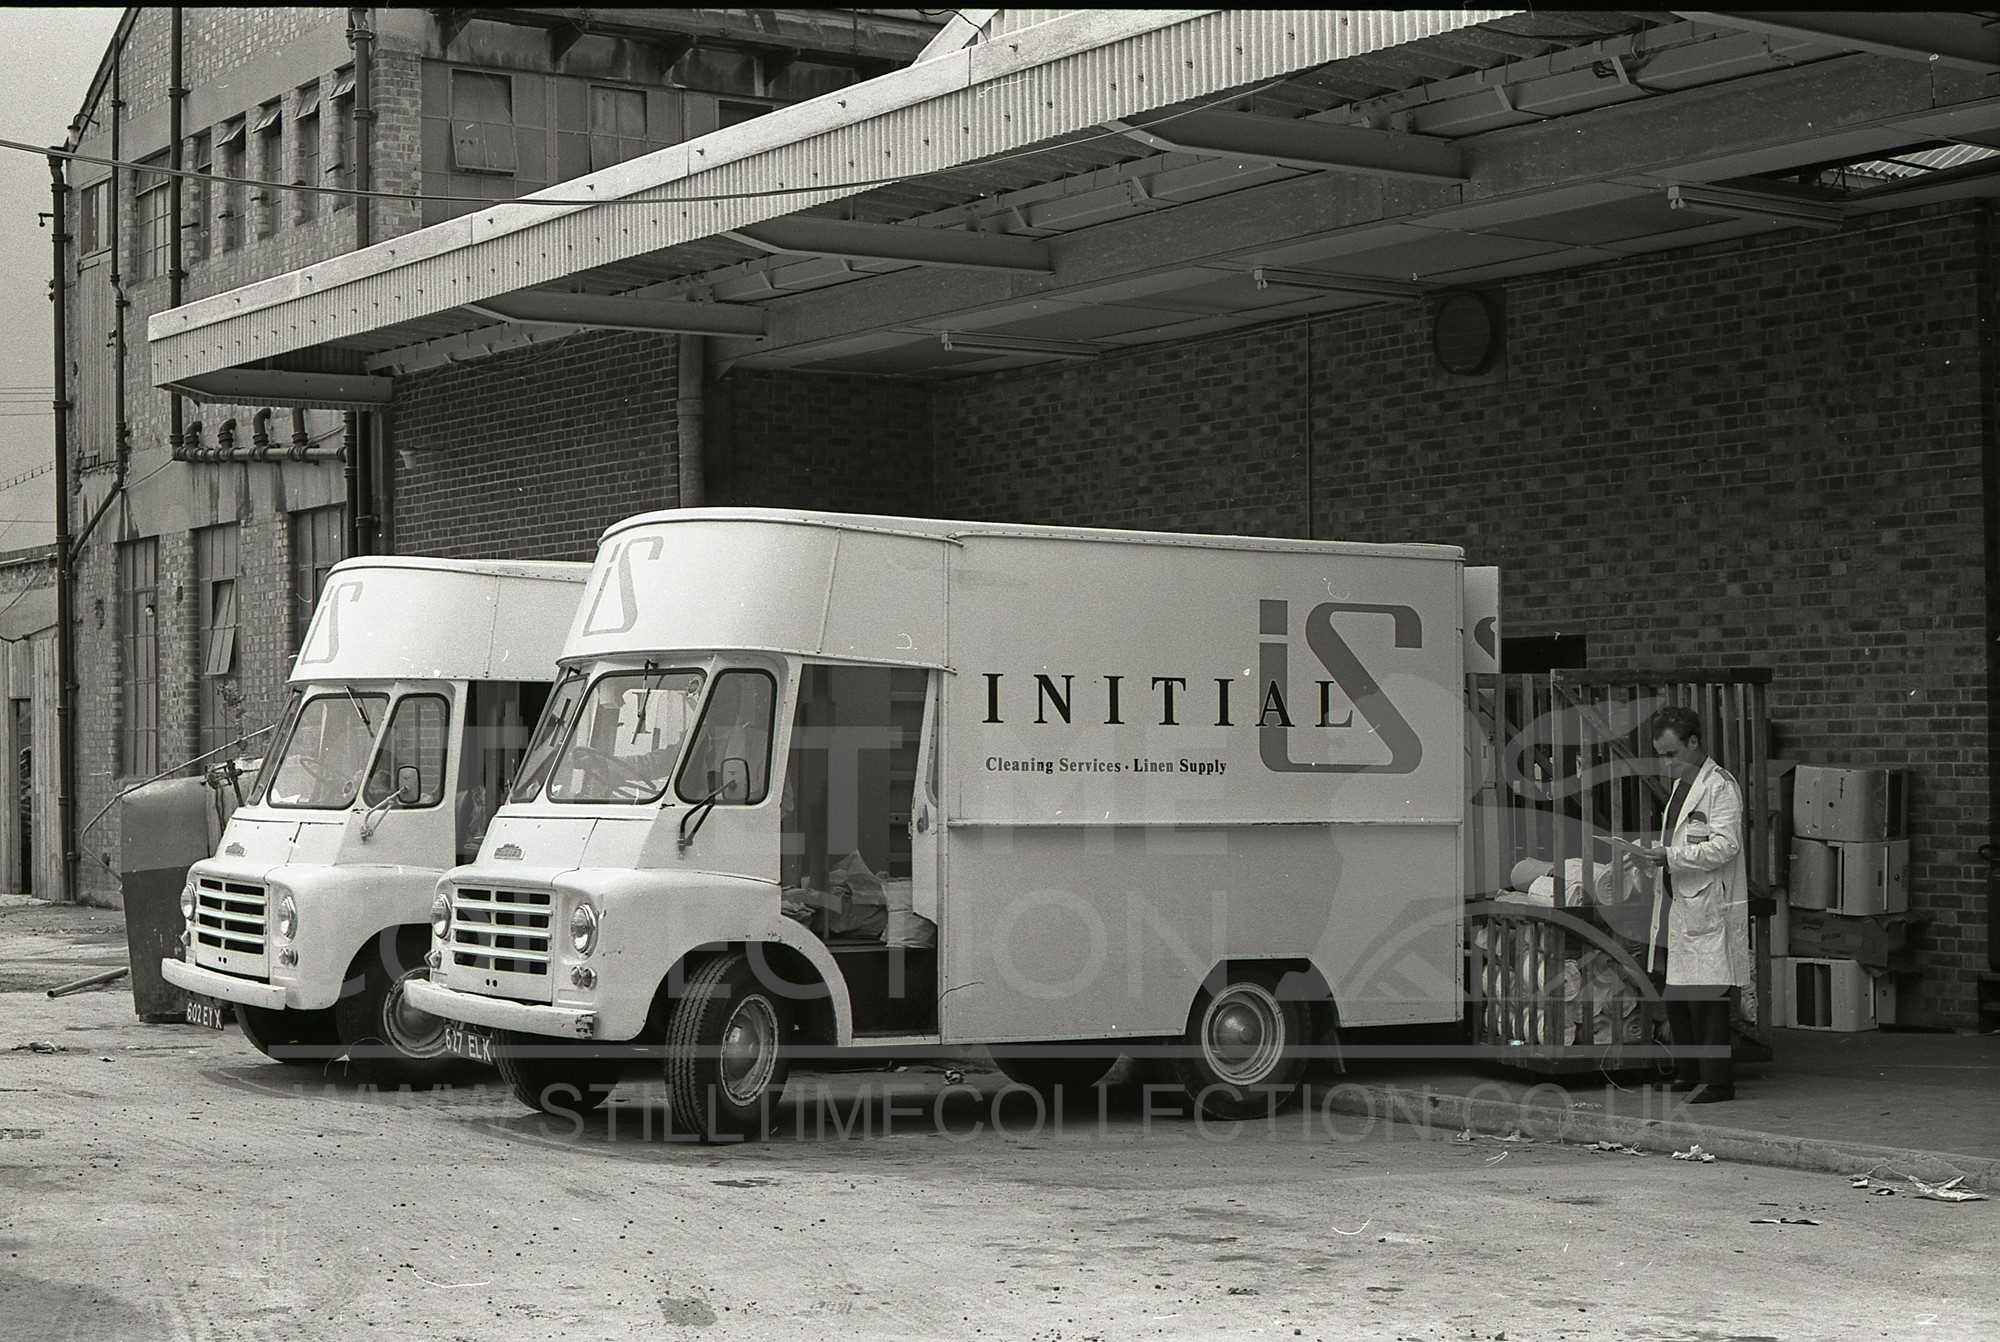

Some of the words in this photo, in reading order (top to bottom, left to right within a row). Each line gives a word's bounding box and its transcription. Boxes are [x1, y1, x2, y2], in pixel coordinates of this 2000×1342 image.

[981, 672, 1354, 728] INITIAL
[985, 756, 1054, 774] Cleaning
[1059, 757, 1122, 773] Services
[1134, 758, 1174, 773] Linen
[1179, 758, 1228, 775] Supply
[468, 1034, 492, 1062] ELK
